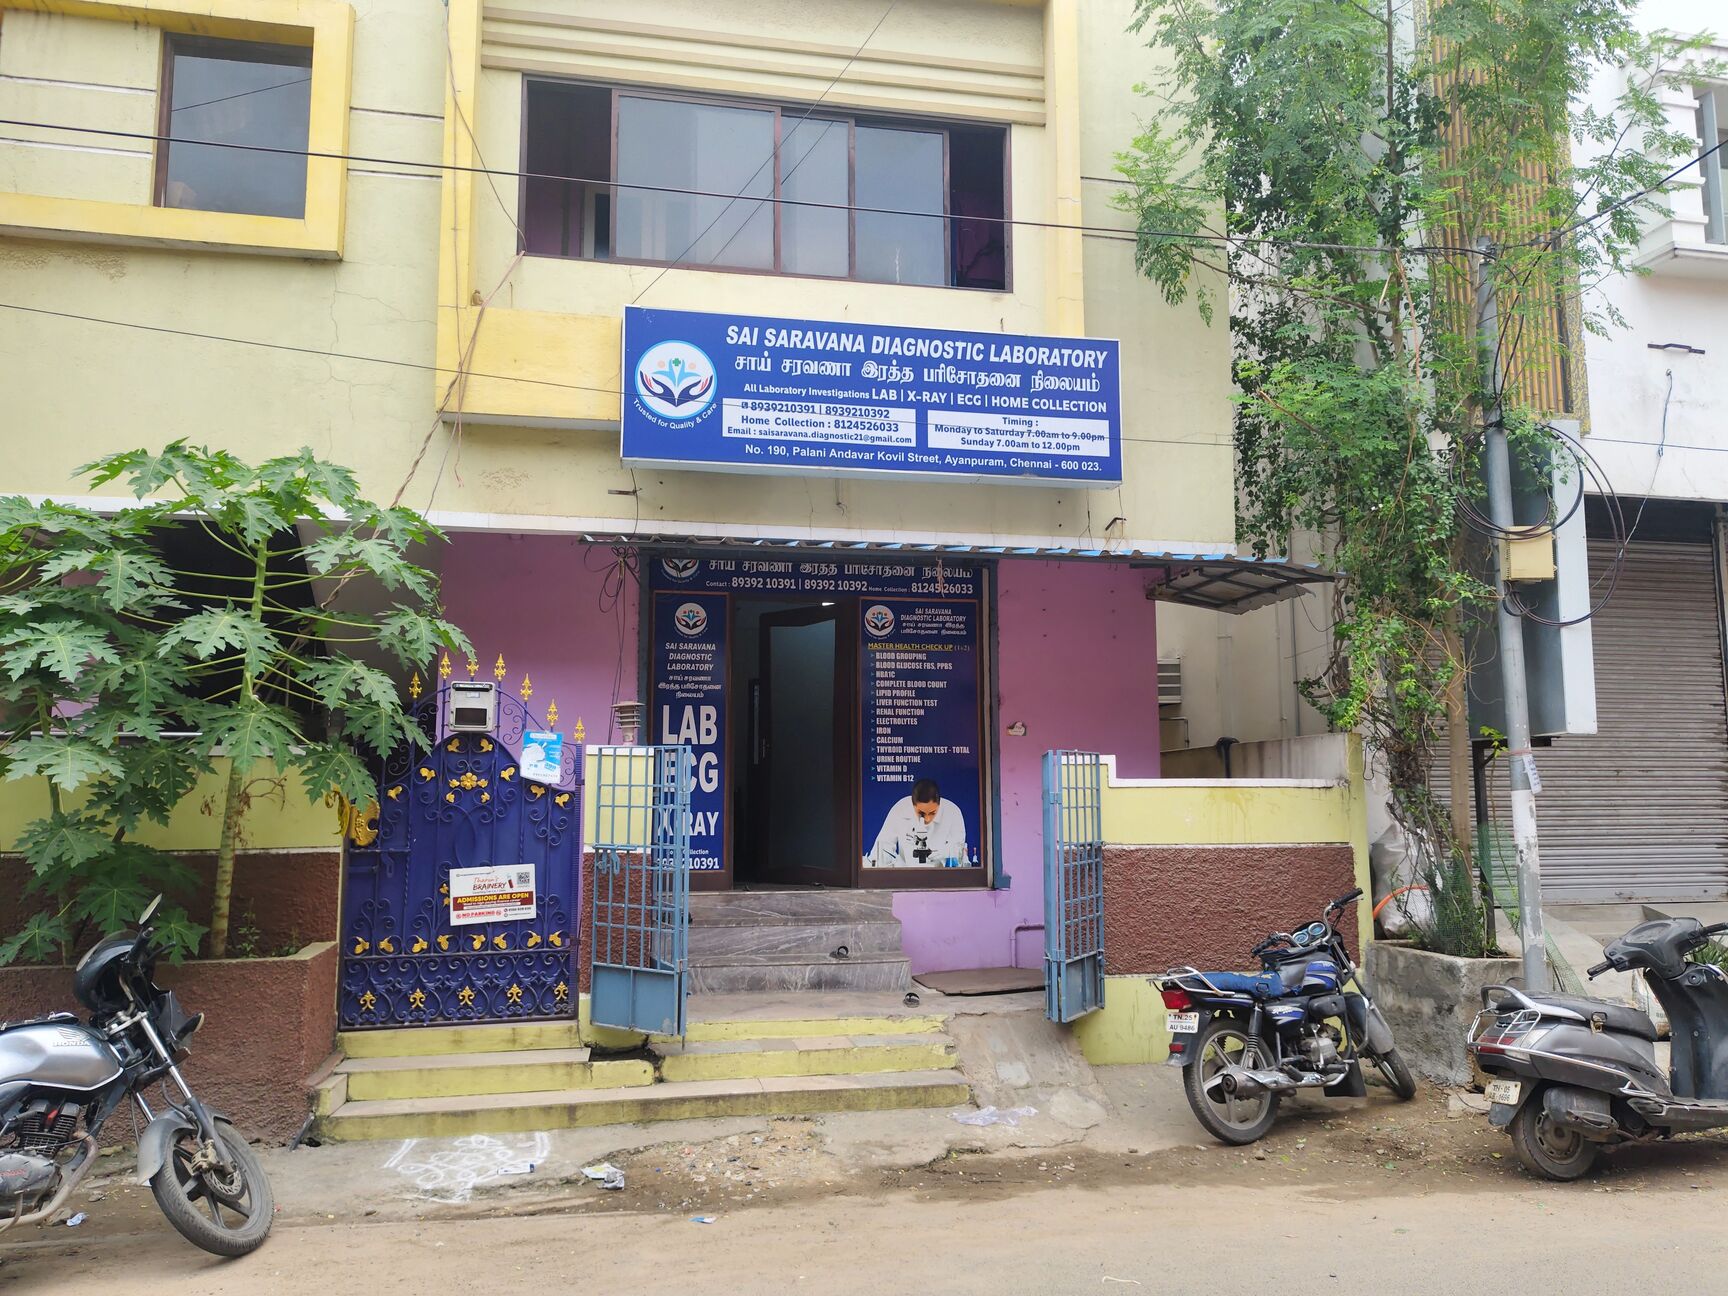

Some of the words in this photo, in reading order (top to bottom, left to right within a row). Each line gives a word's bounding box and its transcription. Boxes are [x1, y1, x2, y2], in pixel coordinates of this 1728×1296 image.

[726, 325, 758, 346] SAI
[764, 328, 865, 353] SARAVANA
[872, 336, 984, 361] DIAGNOSTIC
[989, 344, 1107, 368] LABORATORY
[735, 351, 771, 372] சாய்
[781, 358, 851, 377] சரவணா
[861, 360, 914, 384] இரத்த
[924, 363, 1021, 389] பரிசோதனை
[1031, 370, 1101, 392] நிலையம்
[744, 384, 757, 393] All
[759, 384, 807, 396] Laboratory
[809, 386, 869, 399] Investigations
[872, 388, 898, 400] LAB
[907, 390, 947, 404] X-RAY
[957, 393, 981, 406] ECG
[992, 395, 1028, 408] HOME
[1032, 398, 1107, 413] COLLECTION
[633, 398, 657, 423] Trusted
[658, 419, 668, 428] for
[670, 419, 695, 430] Quality
[702, 402, 717, 419] Care
[751, 402, 816, 414] 8939210391
[825, 406, 889, 419] 8939210392
[742, 415, 770, 426] Home
[775, 417, 824, 428] Collection
[834, 419, 899, 432] 8124526033
[1003, 416, 1033, 427] Timing
[728, 427, 751, 435] Email
[759, 428, 912, 444] saisaravana.diagnostic21@gmail.com
[935, 424, 972, 436] Monday
[974, 426, 982, 435] to
[985, 426, 1025, 439] Saturday
[1027, 430, 1059, 438] 7.00am
[1061, 431, 1070, 439] to
[1072, 432, 1105, 443] 9.00pm
[961, 437, 994, 449] Sunday
[997, 439, 1029, 448] 7.00am
[1031, 441, 1040, 449] to
[1042, 441, 1080, 452] 12.00pm
[746, 444, 763, 455] No.
[768, 445, 789, 457] 190,
[793, 447, 825, 457] Palani
[829, 448, 874, 460] Andavar
[878, 452, 904, 462] Kovil
[908, 452, 942, 465] Street,
[945, 455, 1007, 468] Ayanpuram,
[1010, 458, 1052, 468] Chennai
[1061, 460, 1078, 470] 600
[1082, 461, 1102, 471] 023.
[732, 577, 763, 588] 89392
[766, 578, 796, 589] 10391
[804, 579, 835, 590] 89392
[838, 581, 868, 591] 10392
[662, 705, 718, 745] LAB
[658, 805, 719, 835] XRAY
[457, 895, 498, 903] ADMISSIONS
